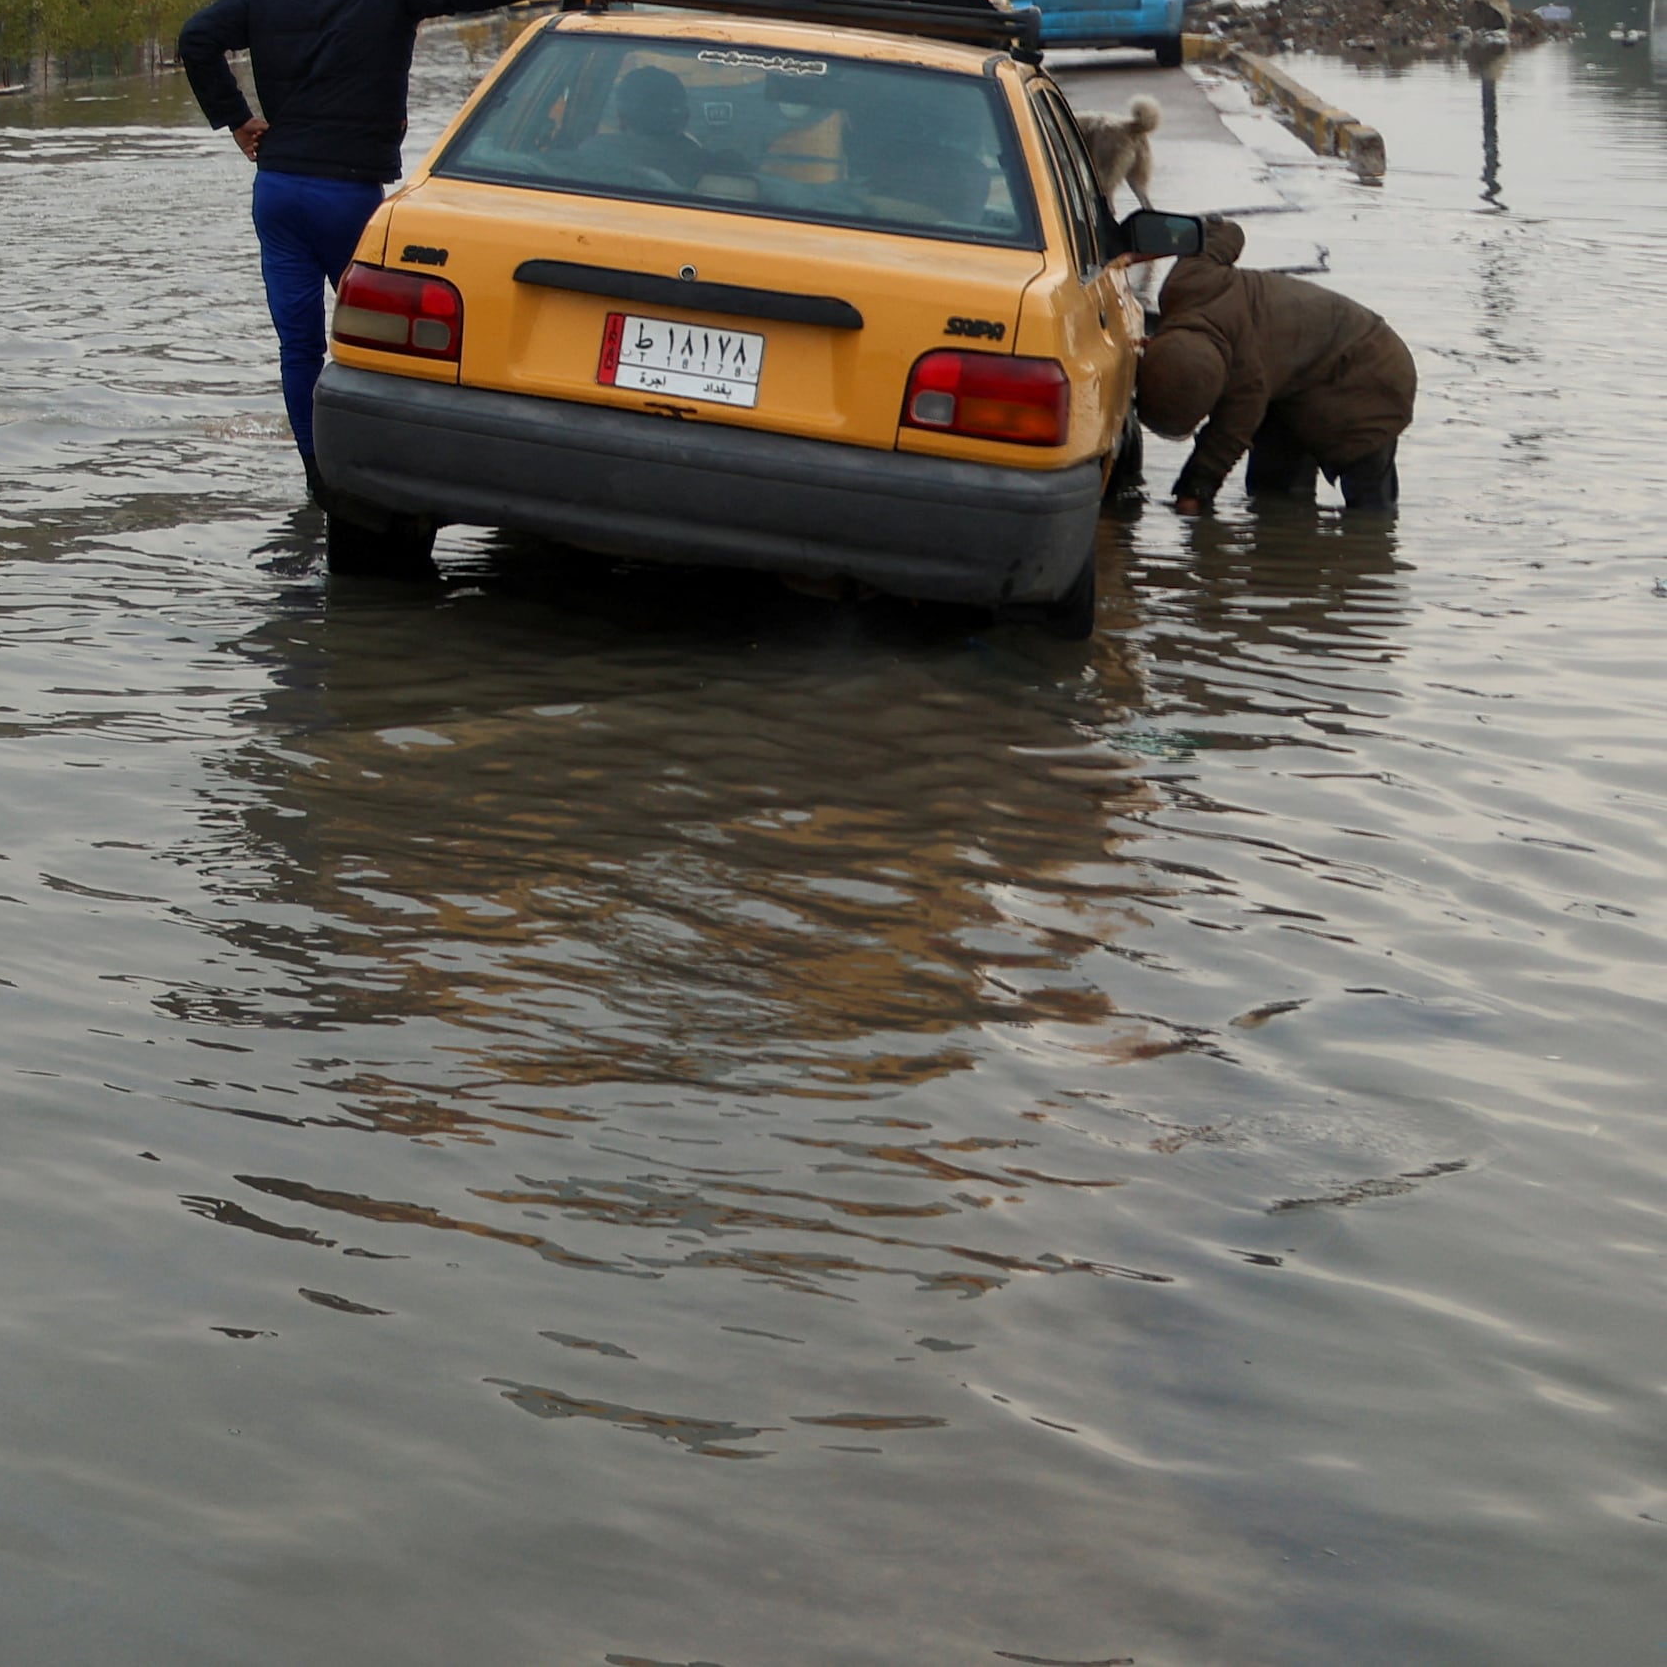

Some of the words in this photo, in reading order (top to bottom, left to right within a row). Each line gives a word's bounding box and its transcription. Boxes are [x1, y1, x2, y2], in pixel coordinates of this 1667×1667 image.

[943, 315, 1006, 342] SAIPA
[635, 322, 653, 349] ط
[669, 327, 747, 366] ١٨١٧٨
[639, 351, 646, 363] T
[666, 356, 741, 378] 18178
[639, 372, 666, 389] اجرة
[703, 382, 732, 400] بغداد
